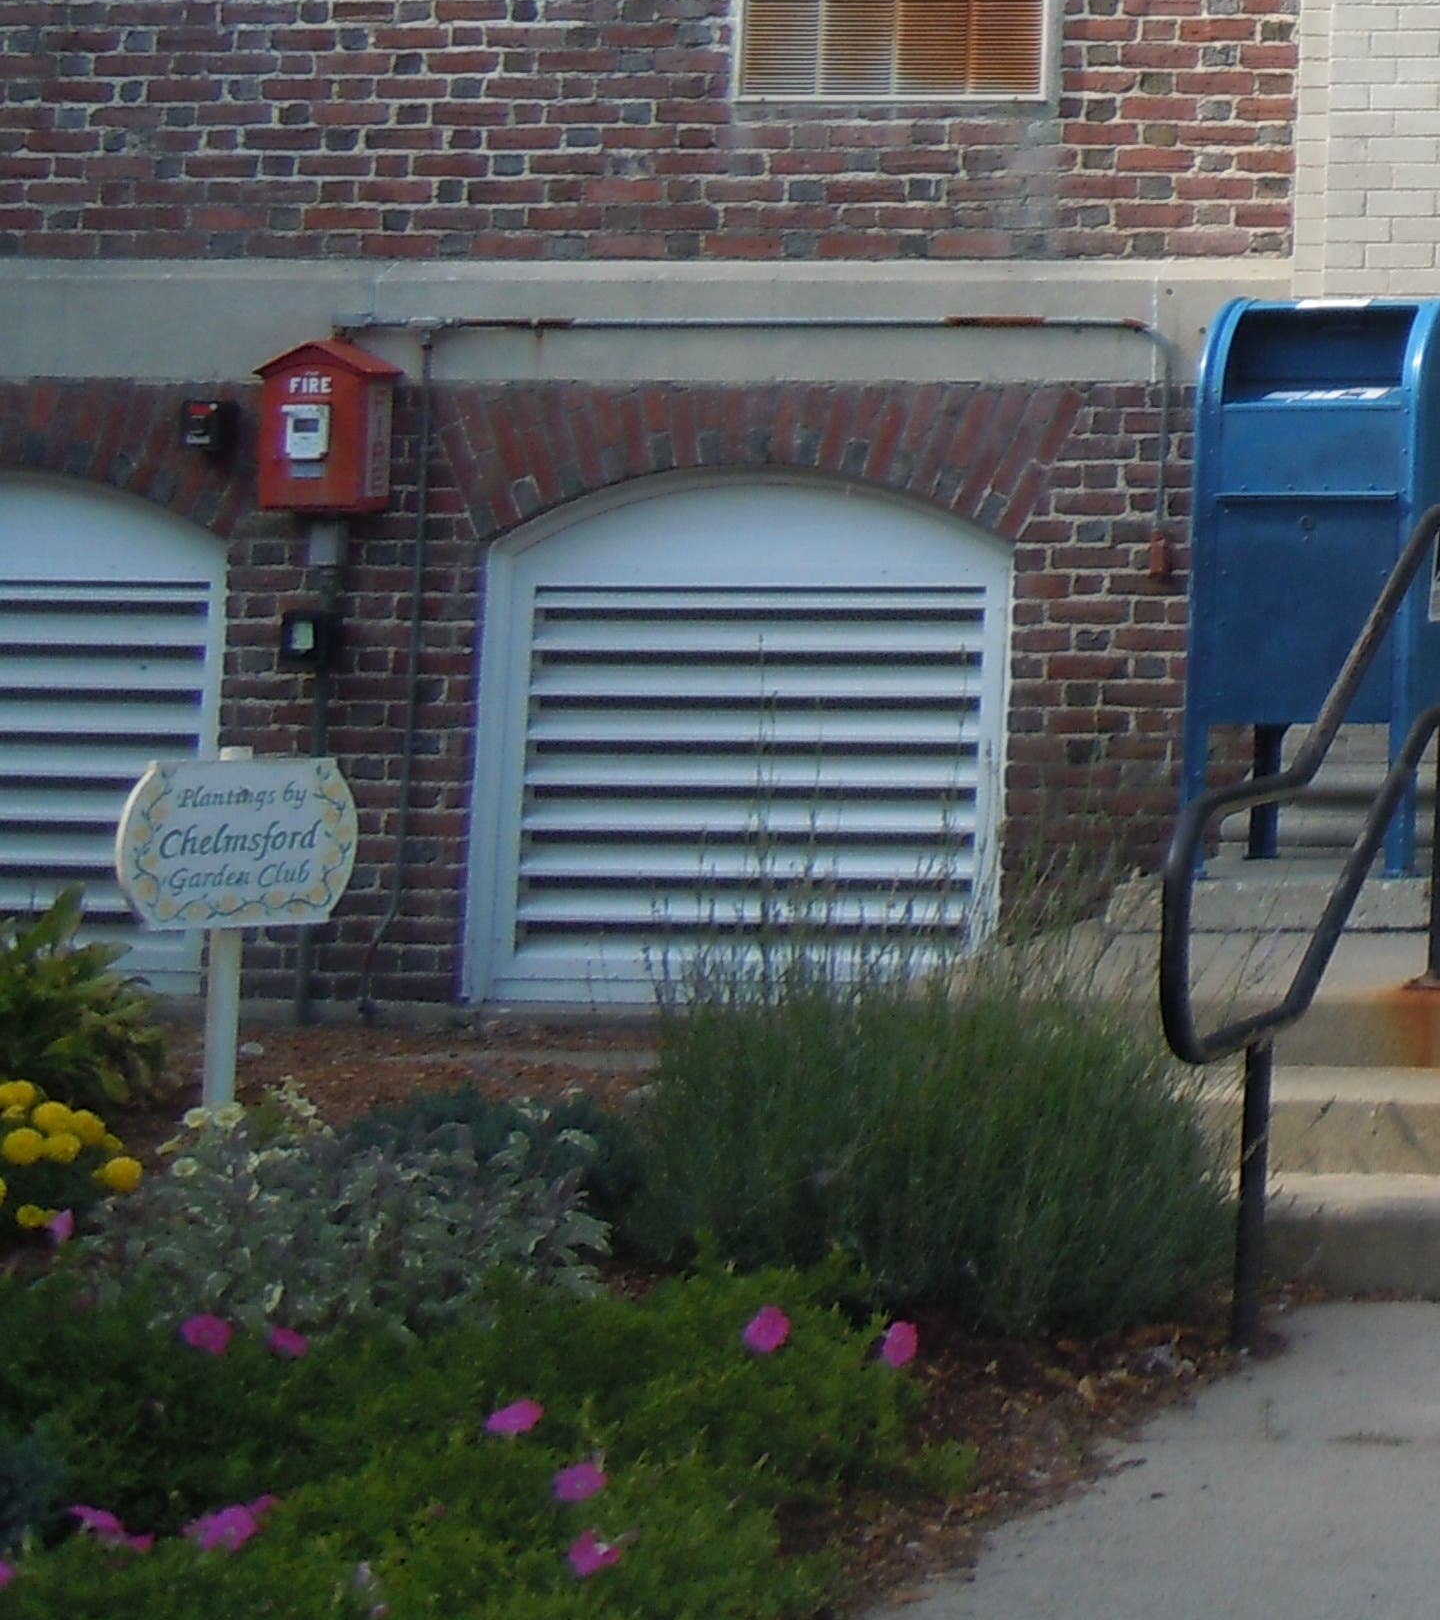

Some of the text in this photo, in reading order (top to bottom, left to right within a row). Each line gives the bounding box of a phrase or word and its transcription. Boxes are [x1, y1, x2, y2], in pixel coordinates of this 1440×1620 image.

[289, 376, 333, 394] FIRE
[177, 781, 307, 811] Plantings by
[160, 820, 322, 861] Chelmsford
[169, 859, 310, 896] Garden Club
